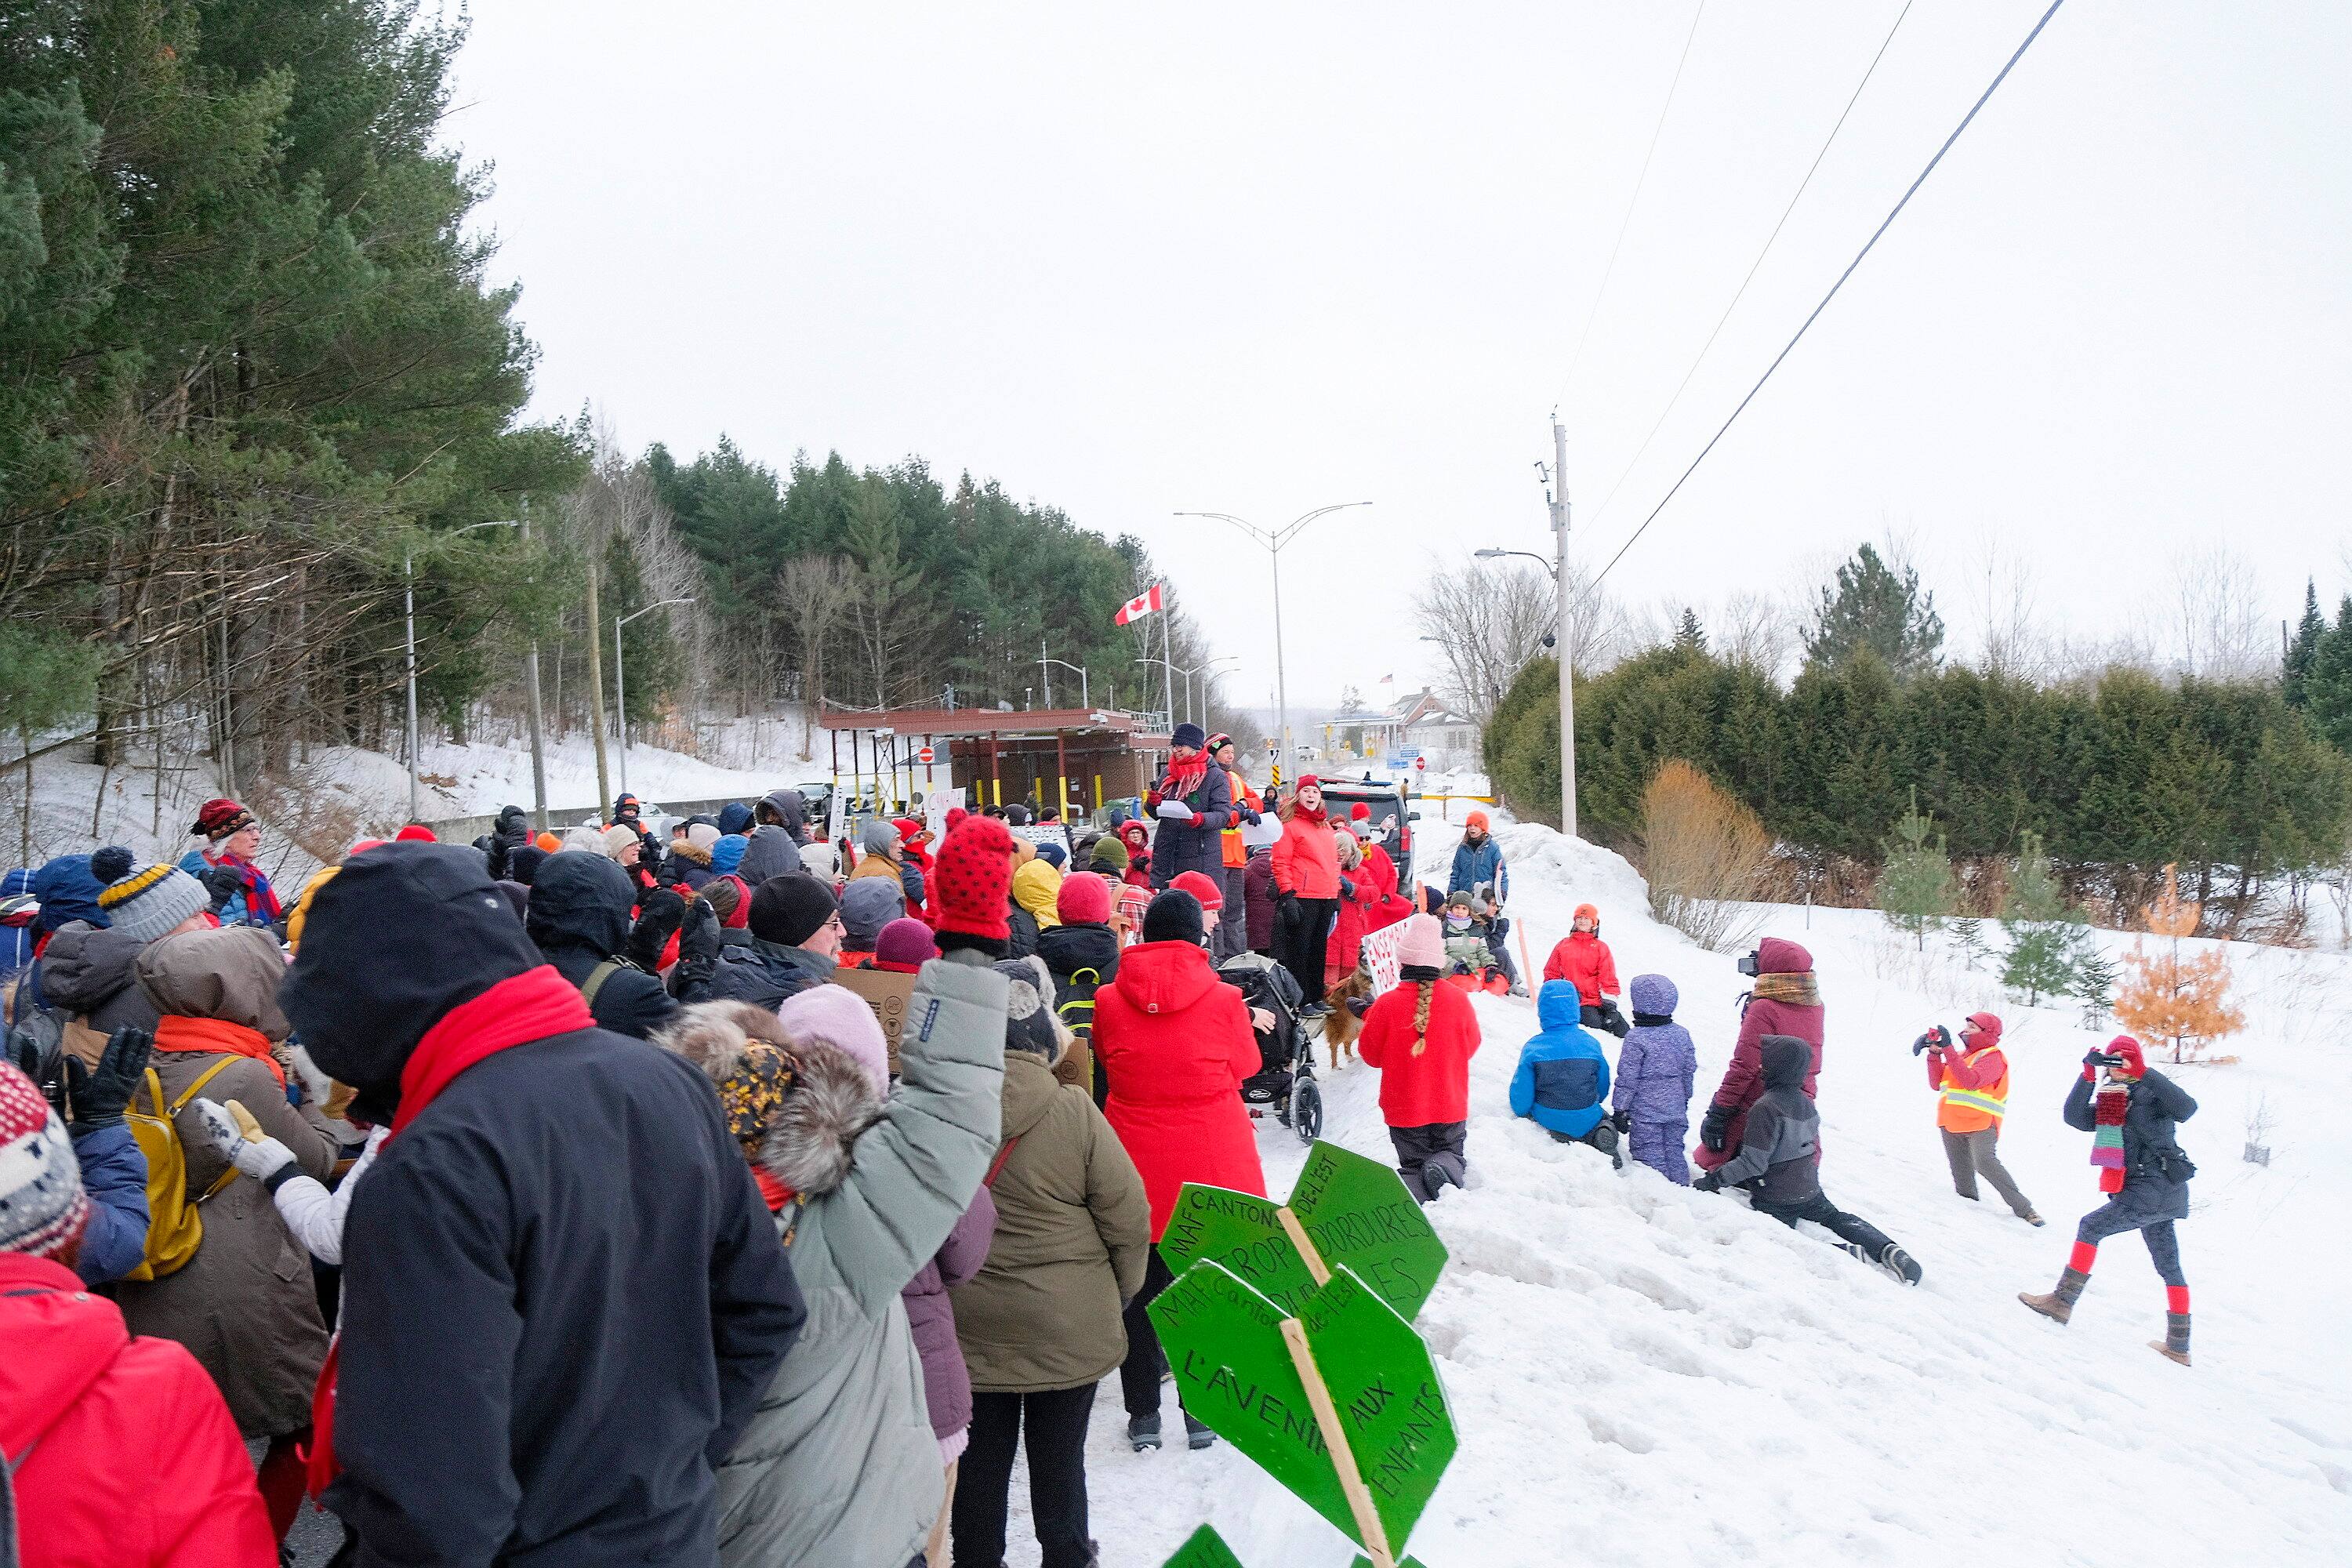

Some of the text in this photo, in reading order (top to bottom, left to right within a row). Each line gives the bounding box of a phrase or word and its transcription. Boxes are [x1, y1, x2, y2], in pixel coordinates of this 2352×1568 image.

[1169, 1207, 1204, 1258] MAF
[1158, 1272, 1214, 1328] MAF
[1348, 1379, 1395, 1432] AUX
[1370, 1382, 1446, 1498] ENFANTS
